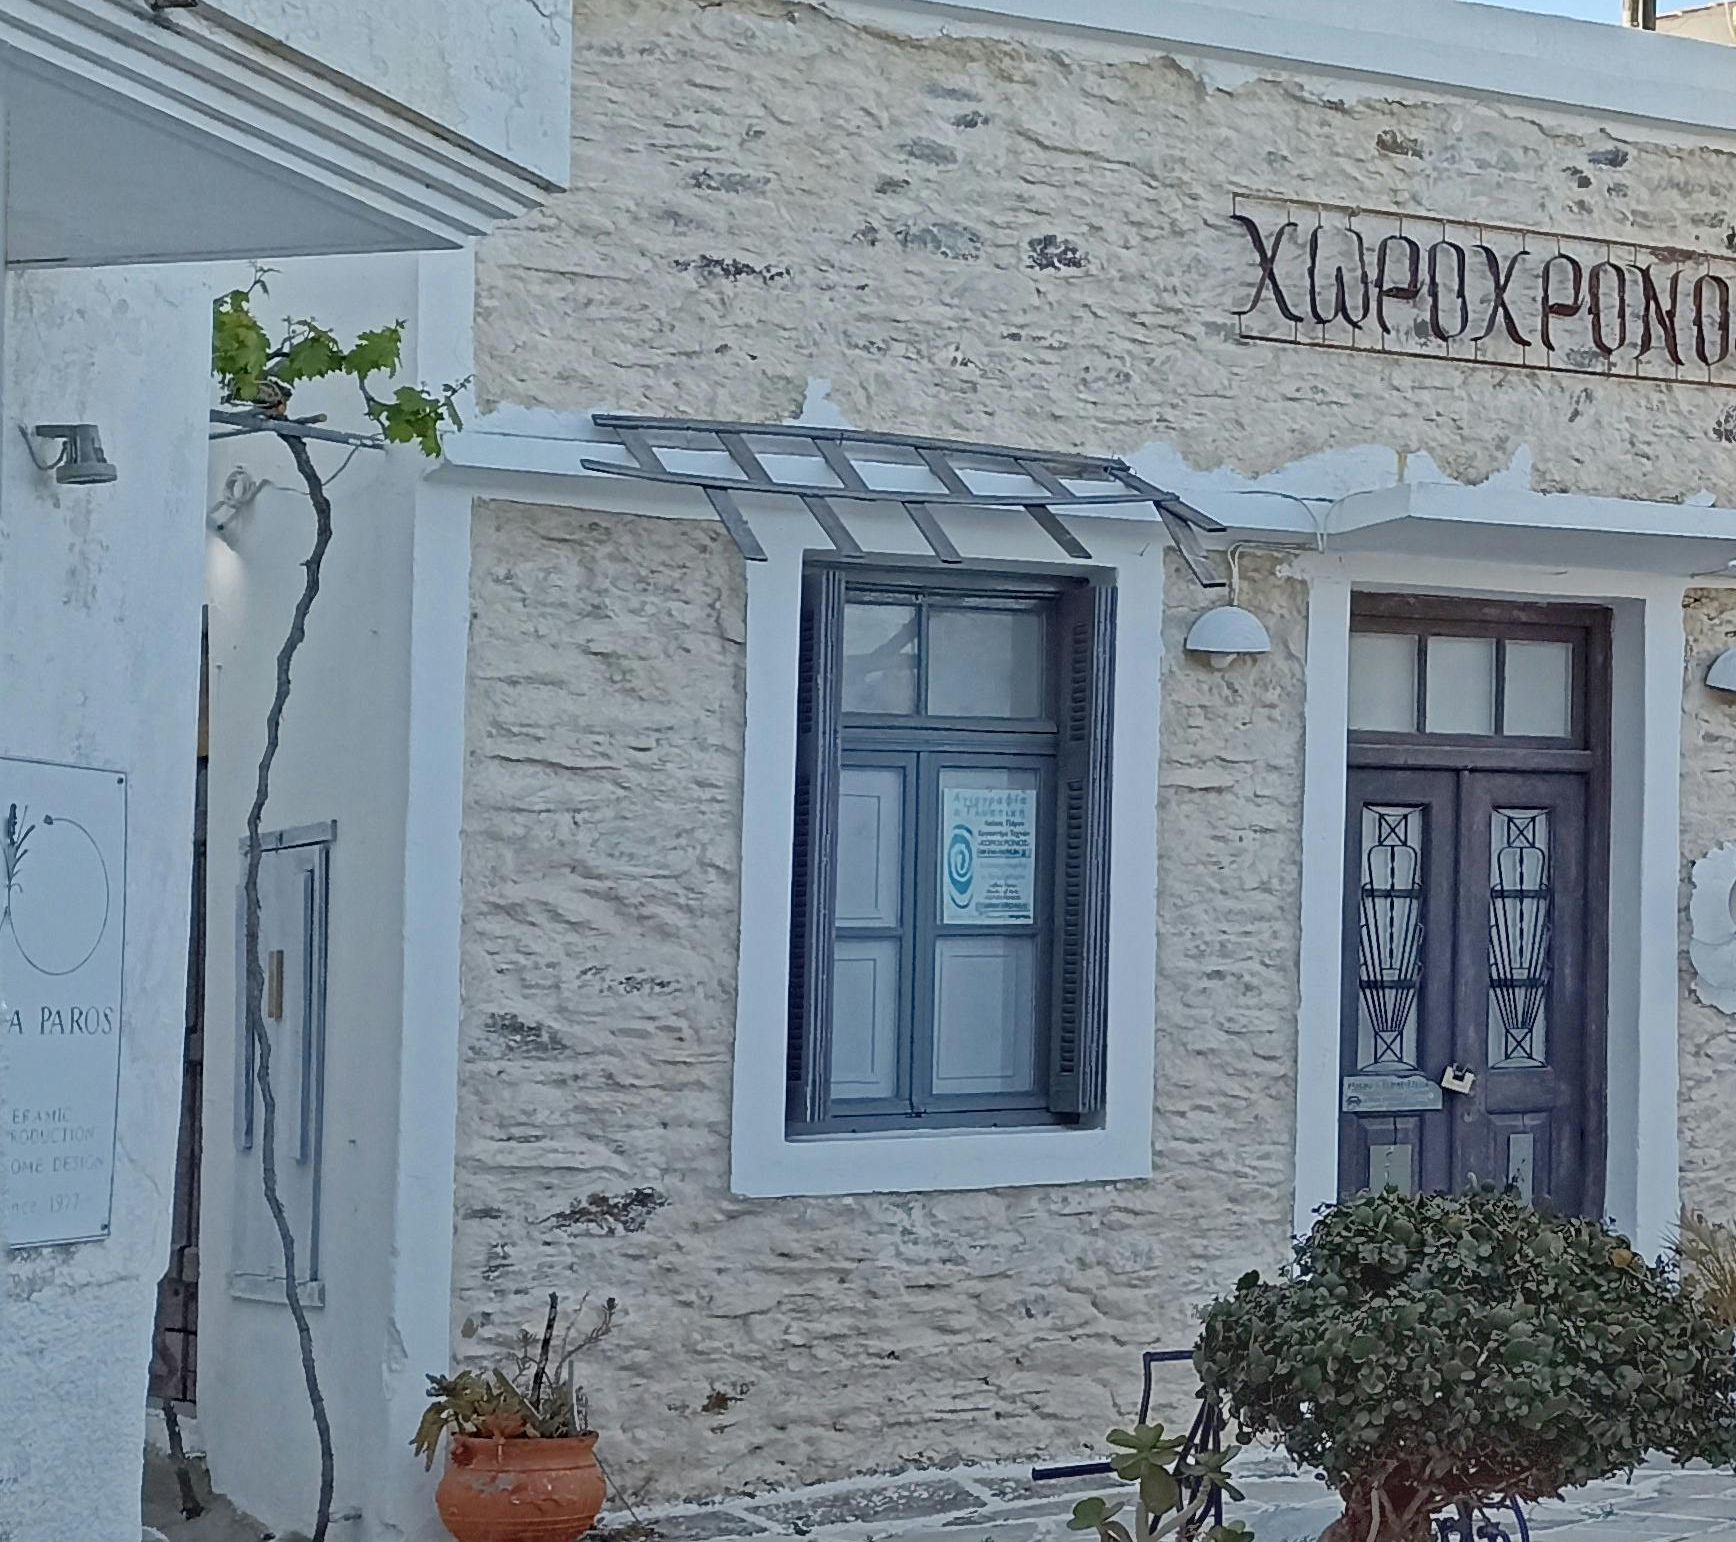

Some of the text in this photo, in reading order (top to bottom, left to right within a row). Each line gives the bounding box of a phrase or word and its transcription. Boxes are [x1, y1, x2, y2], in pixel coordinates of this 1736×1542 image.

[40, 1005, 114, 1036] PAROS
[12, 1106, 72, 1125] ERAMIC
[10, 1158, 43, 1175] OME
